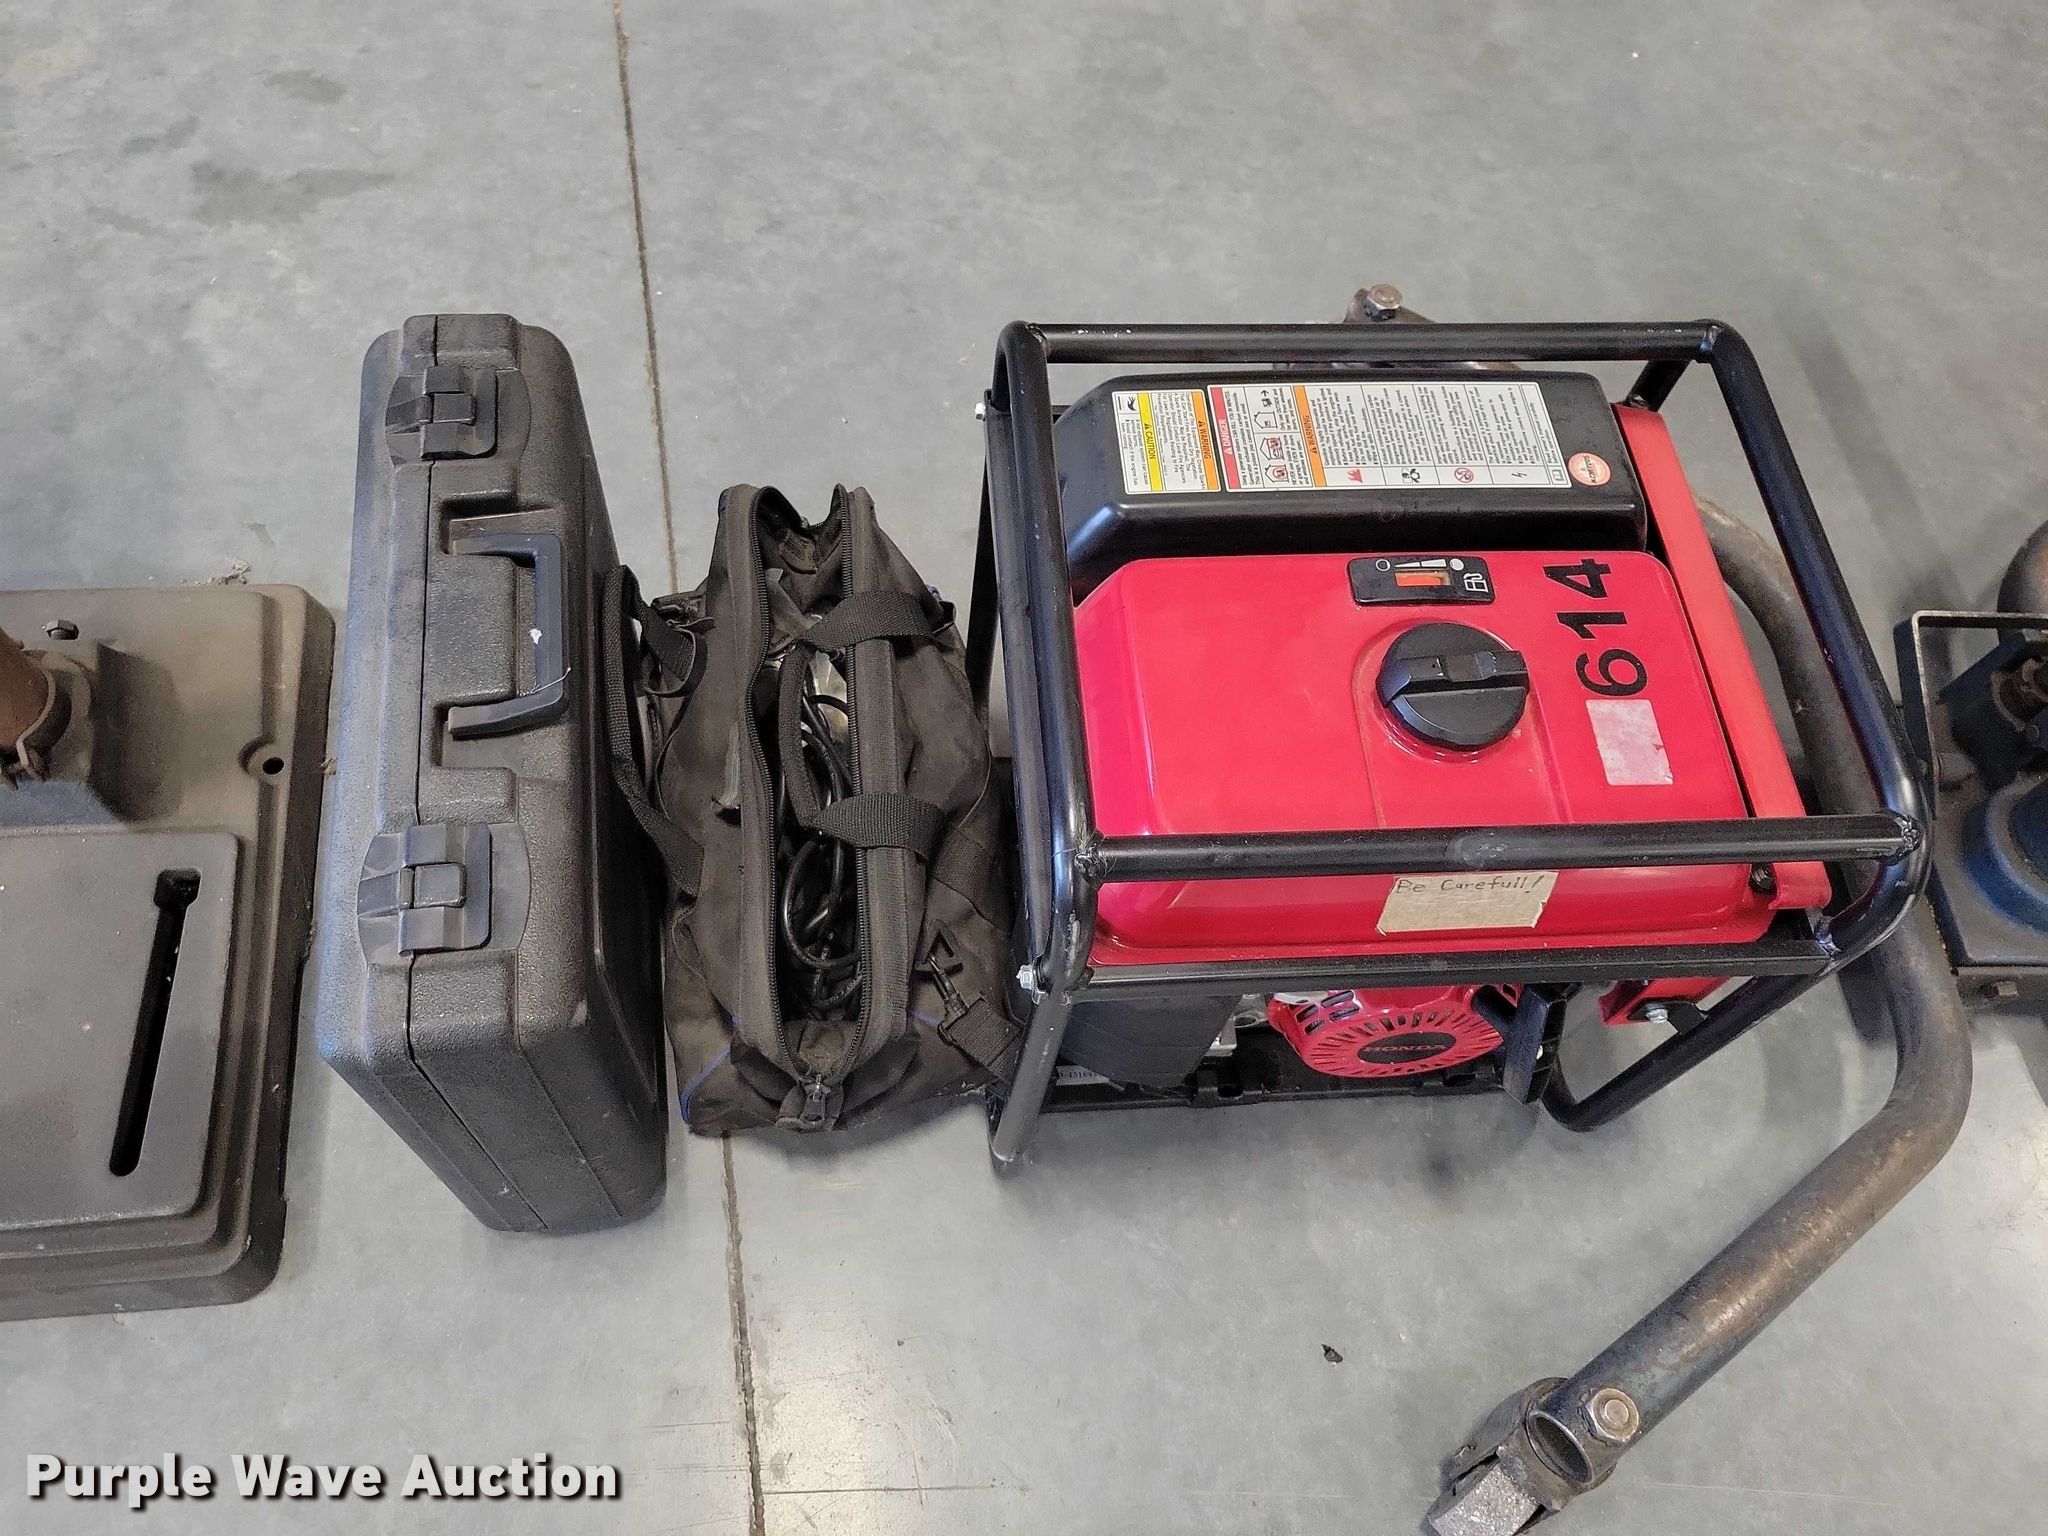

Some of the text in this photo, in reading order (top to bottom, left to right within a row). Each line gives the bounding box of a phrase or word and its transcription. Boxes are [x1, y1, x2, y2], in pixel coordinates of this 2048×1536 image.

[1199, 428, 1211, 458] WARNING
[1218, 418, 1231, 446] DANGER
[1301, 415, 1315, 445] WARNING
[1145, 431, 1156, 459] CAUTION
[1543, 559, 1647, 696] 614
[1396, 878, 1426, 894] Be
